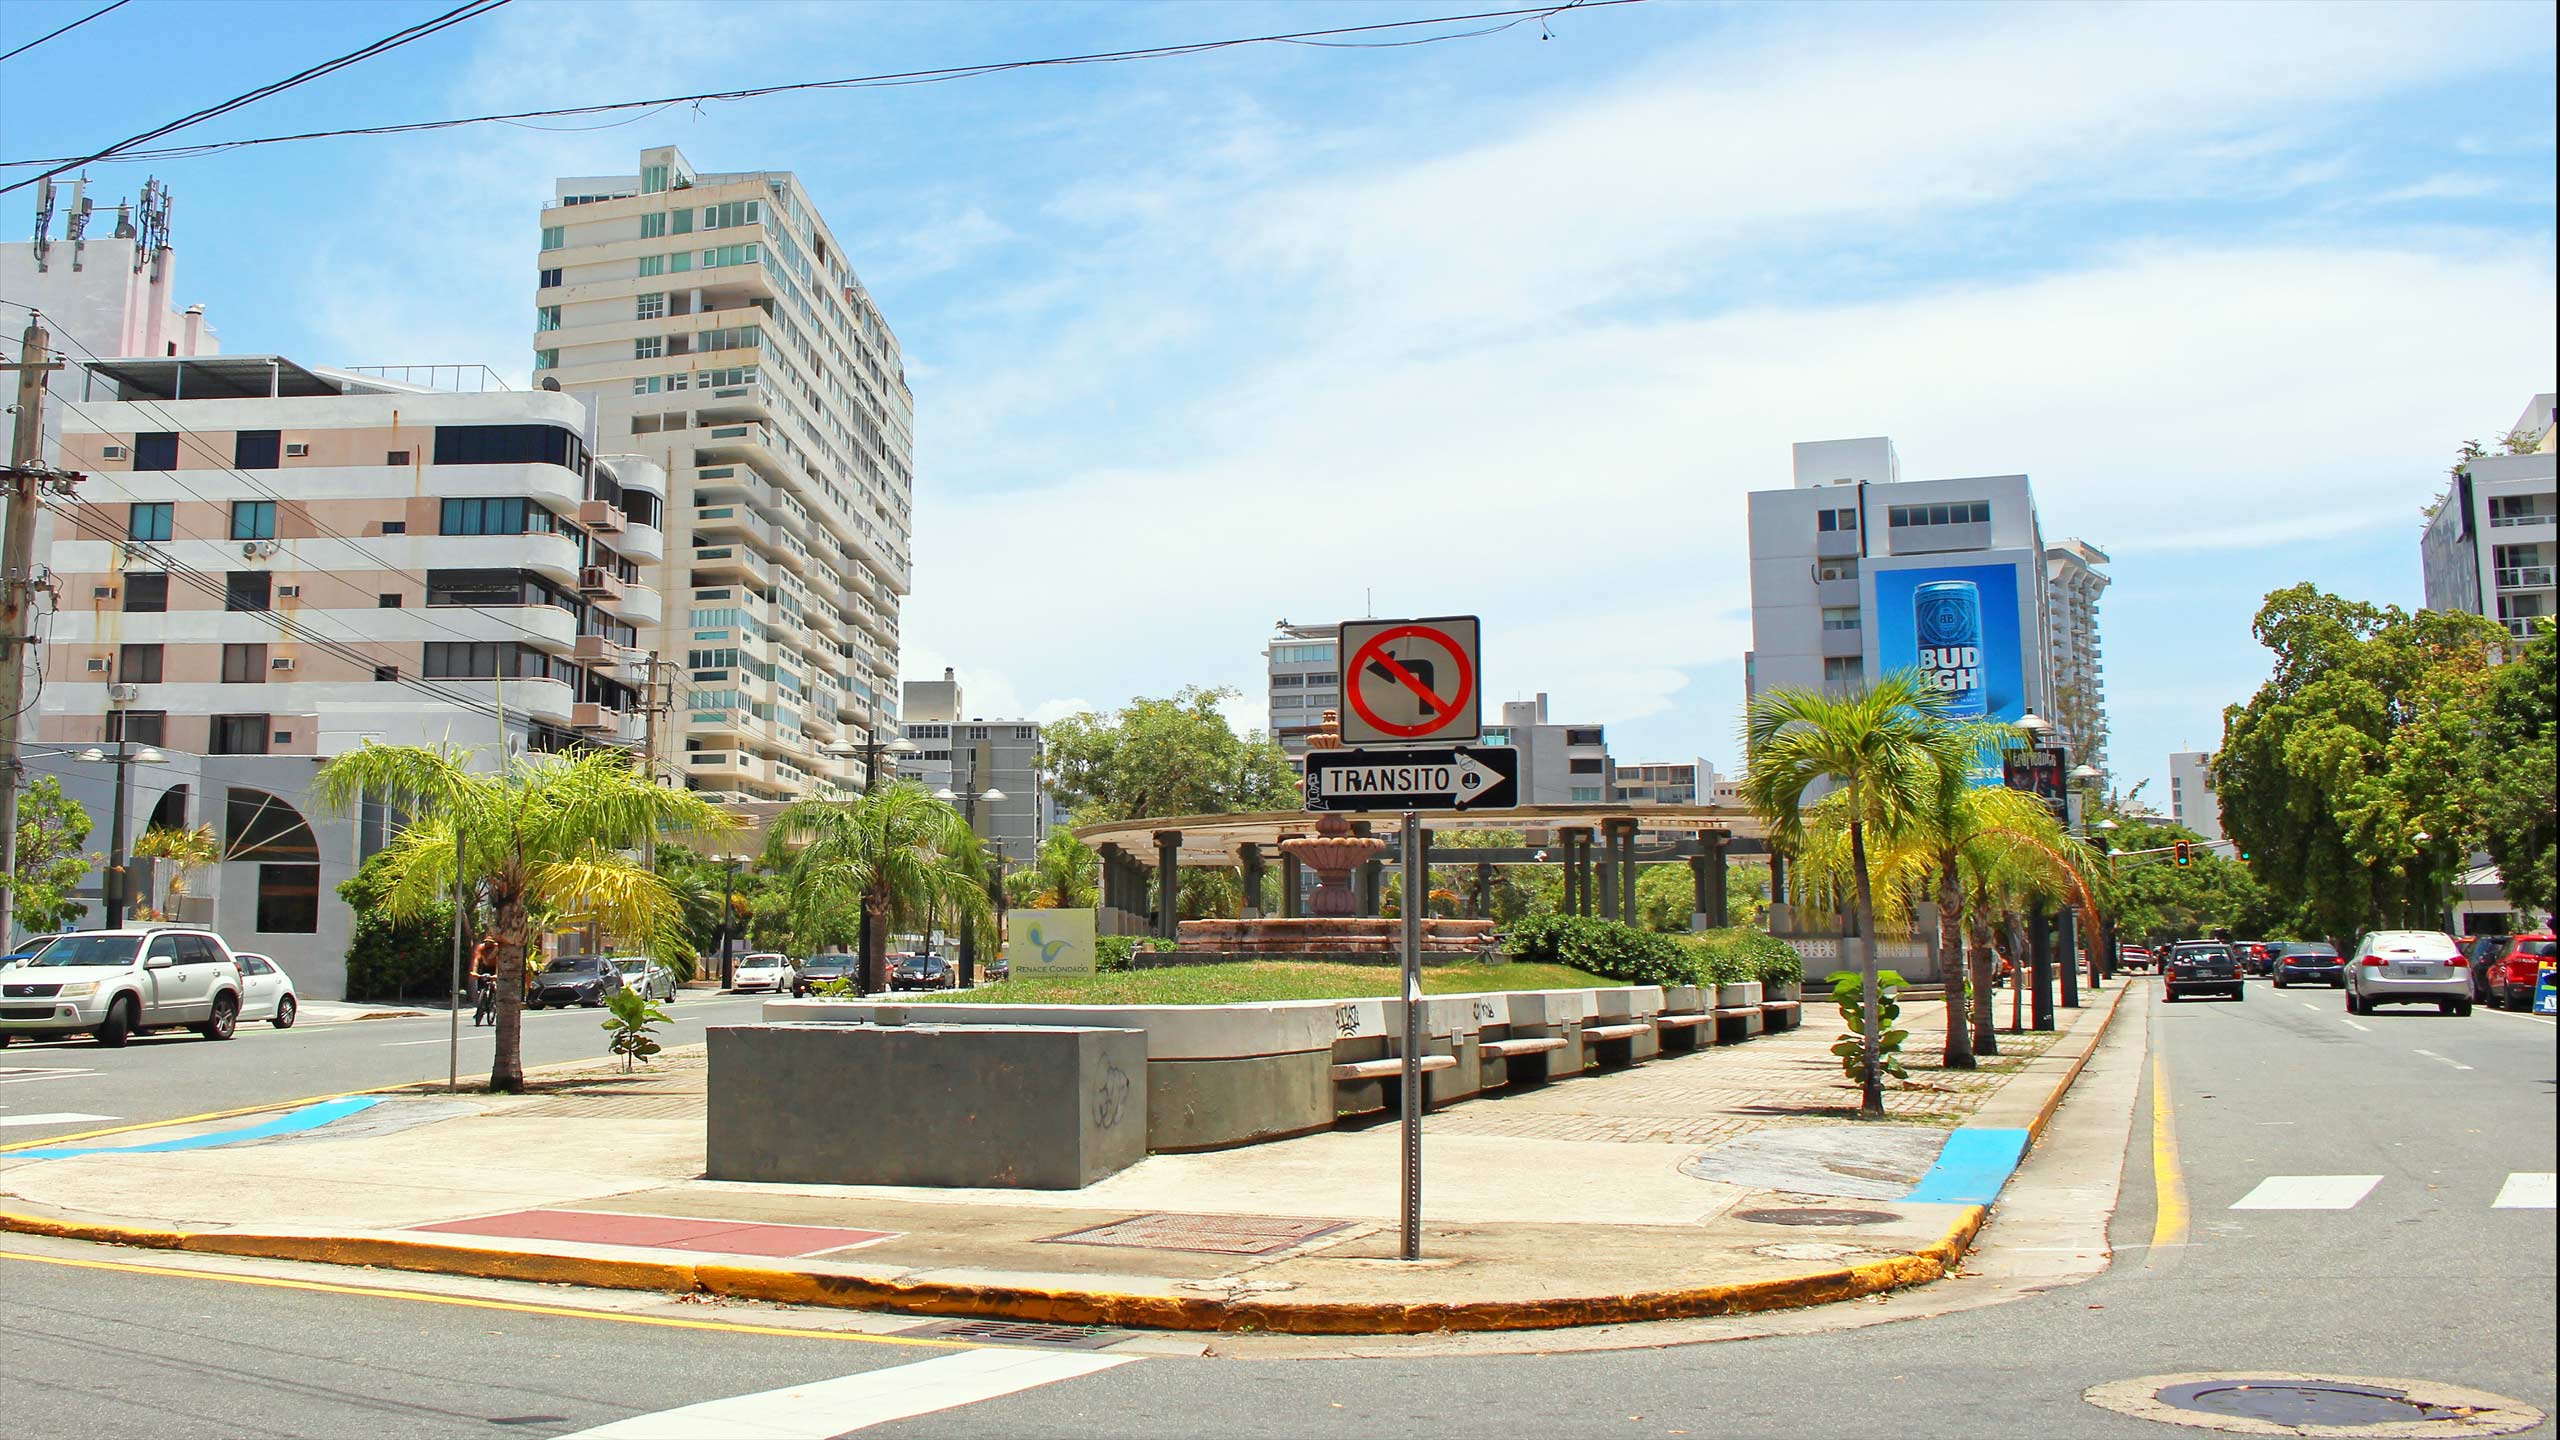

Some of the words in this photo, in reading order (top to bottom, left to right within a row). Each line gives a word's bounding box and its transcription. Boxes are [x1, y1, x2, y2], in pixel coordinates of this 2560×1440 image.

[1920, 647, 1980, 670] BUD
[1921, 668, 1980, 692] IGH
[1331, 768, 1449, 793] TRANSITO
[1016, 965, 1048, 973] RENACE
[1049, 965, 1088, 973] CONDADO
